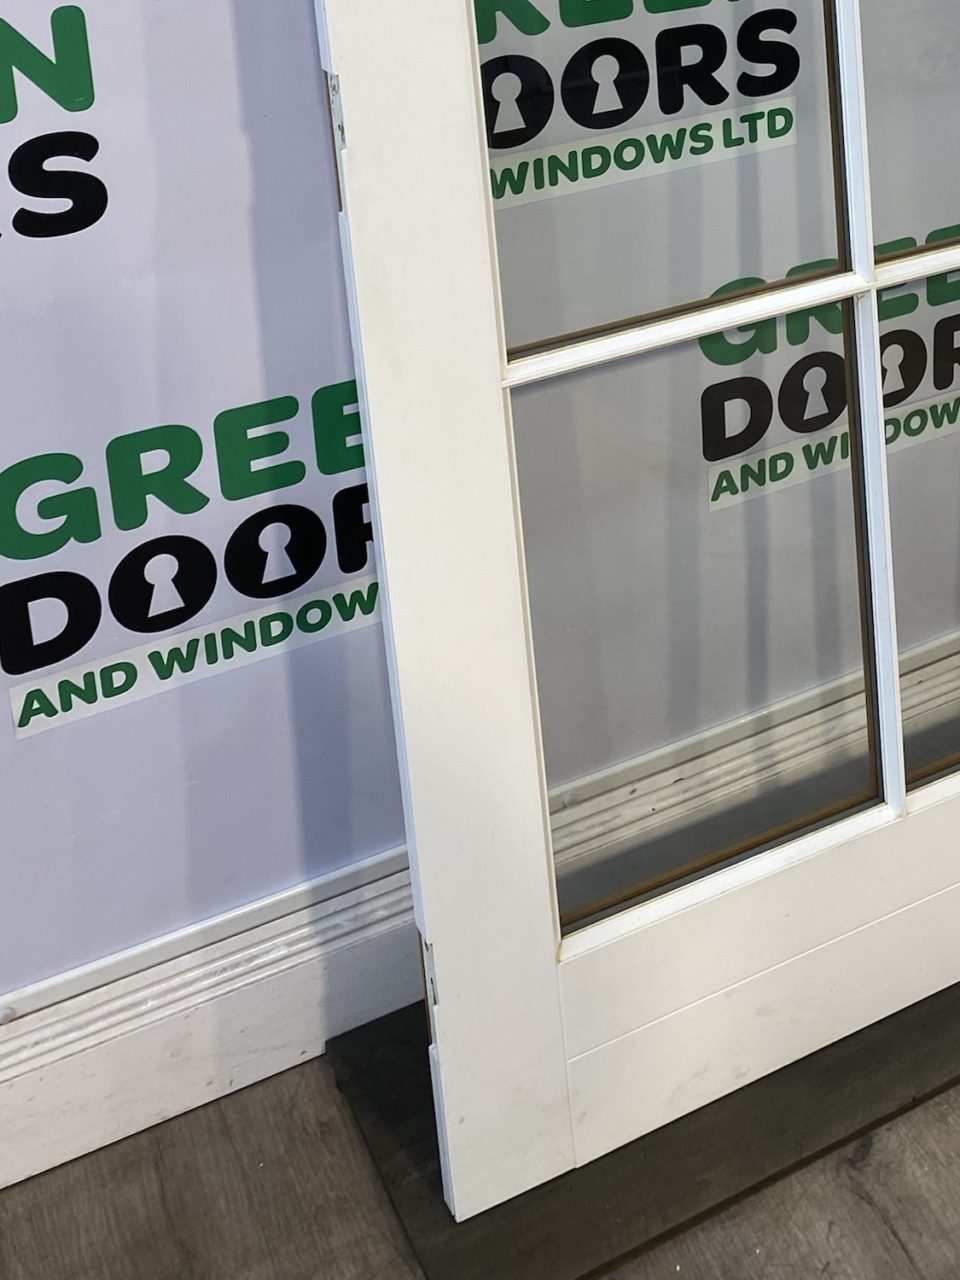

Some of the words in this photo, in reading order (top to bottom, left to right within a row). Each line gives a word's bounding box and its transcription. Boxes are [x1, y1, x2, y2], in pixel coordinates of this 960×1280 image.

[489, 122, 715, 200] WINDOWS
[722, 106, 794, 148] LTD
[710, 451, 795, 502] AND
[18, 661, 138, 728] AND
